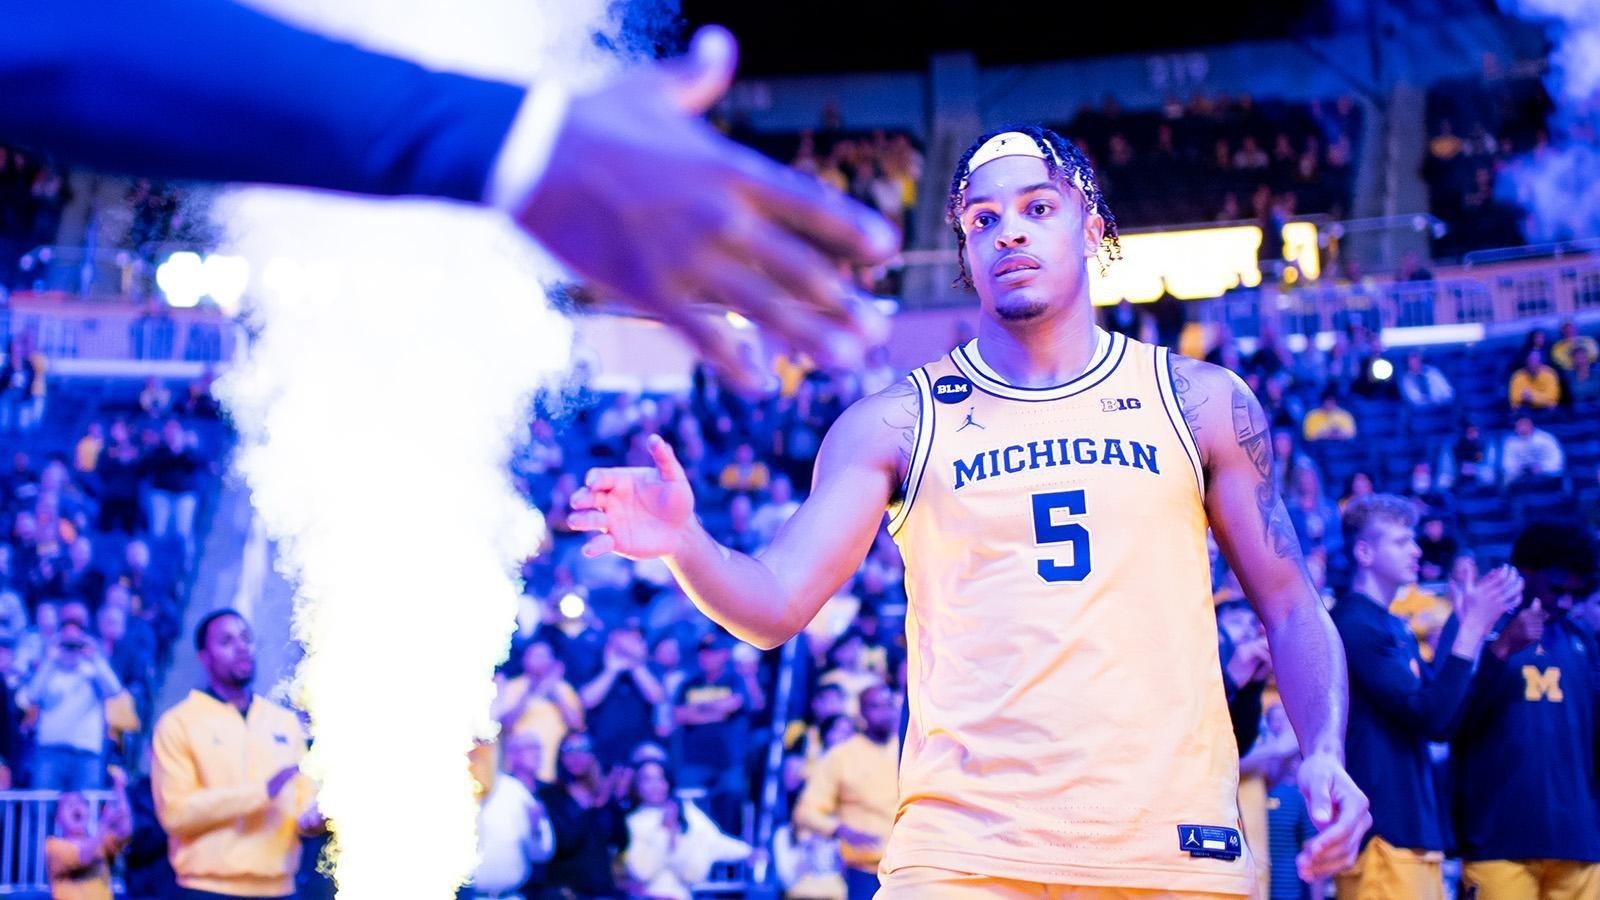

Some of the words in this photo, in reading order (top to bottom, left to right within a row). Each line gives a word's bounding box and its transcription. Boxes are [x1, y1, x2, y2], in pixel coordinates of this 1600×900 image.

[937, 384, 967, 394] BLM
[953, 438, 1160, 490] MICHIGAN
[1031, 489, 1092, 583] 5
[1522, 665, 1564, 702] M
